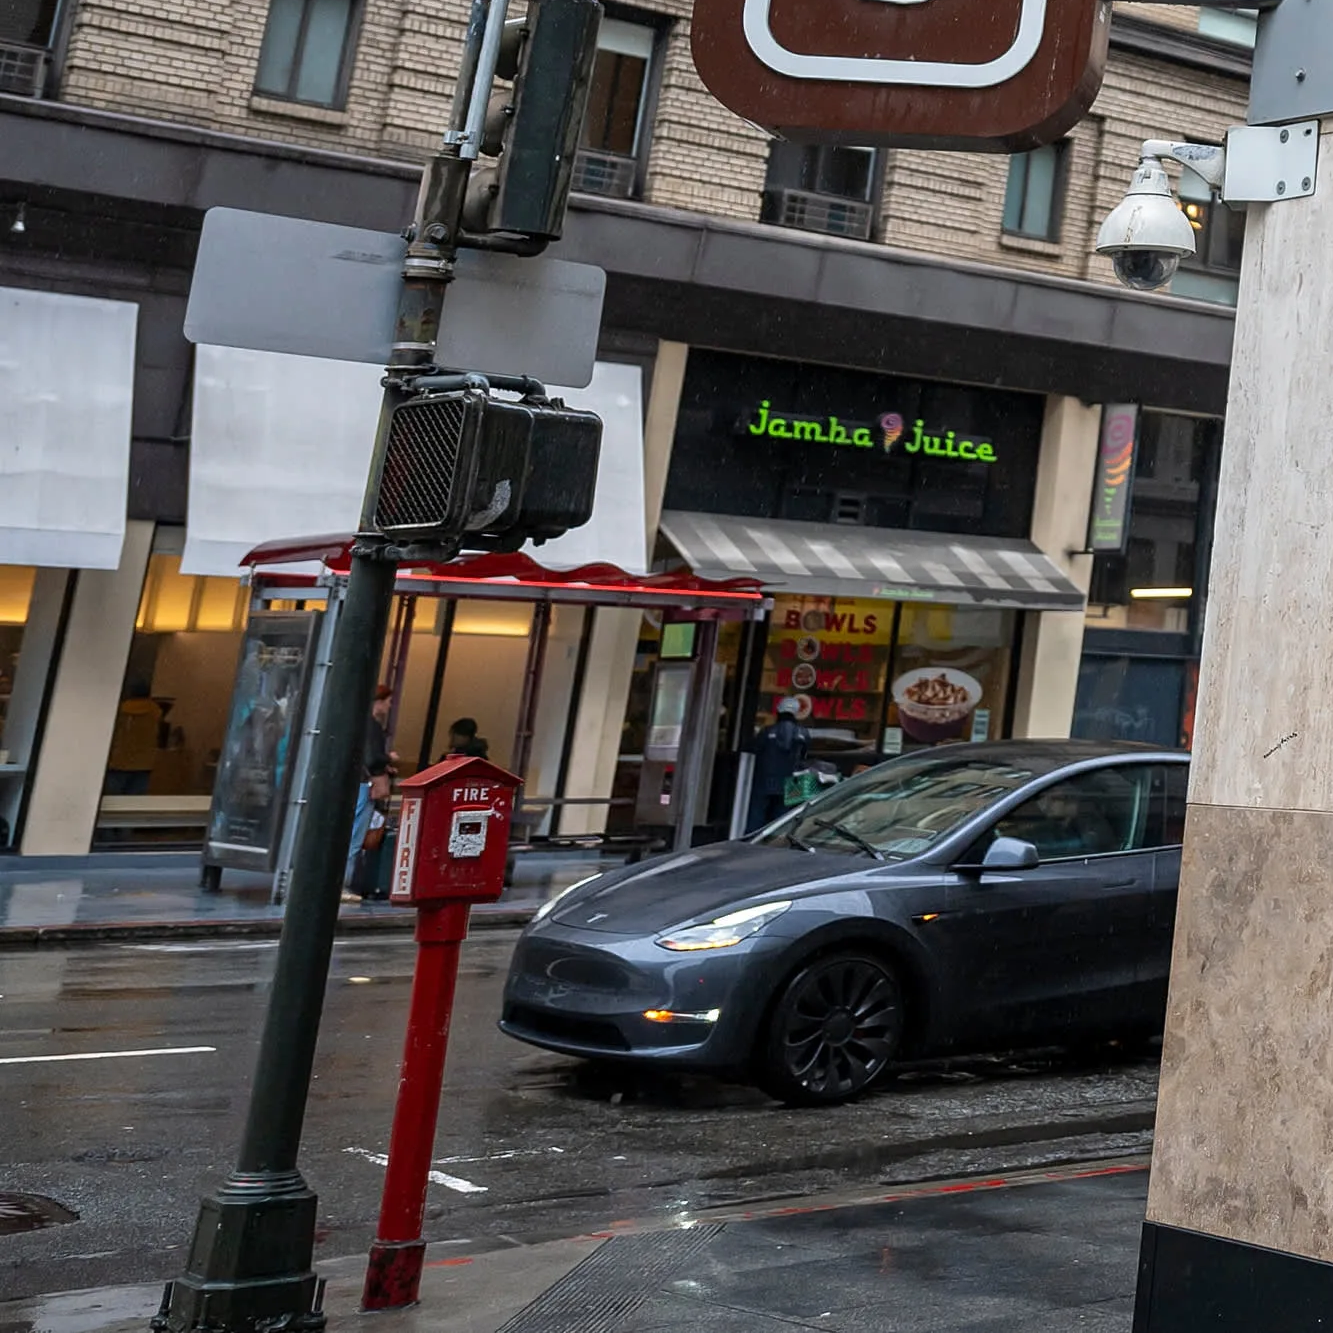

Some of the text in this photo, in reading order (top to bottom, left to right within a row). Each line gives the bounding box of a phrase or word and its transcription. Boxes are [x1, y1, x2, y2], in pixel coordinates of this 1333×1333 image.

[749, 400, 998, 462] jamba juice
[452, 787, 489, 802] FIRE
[399, 800, 416, 892] FIRE
